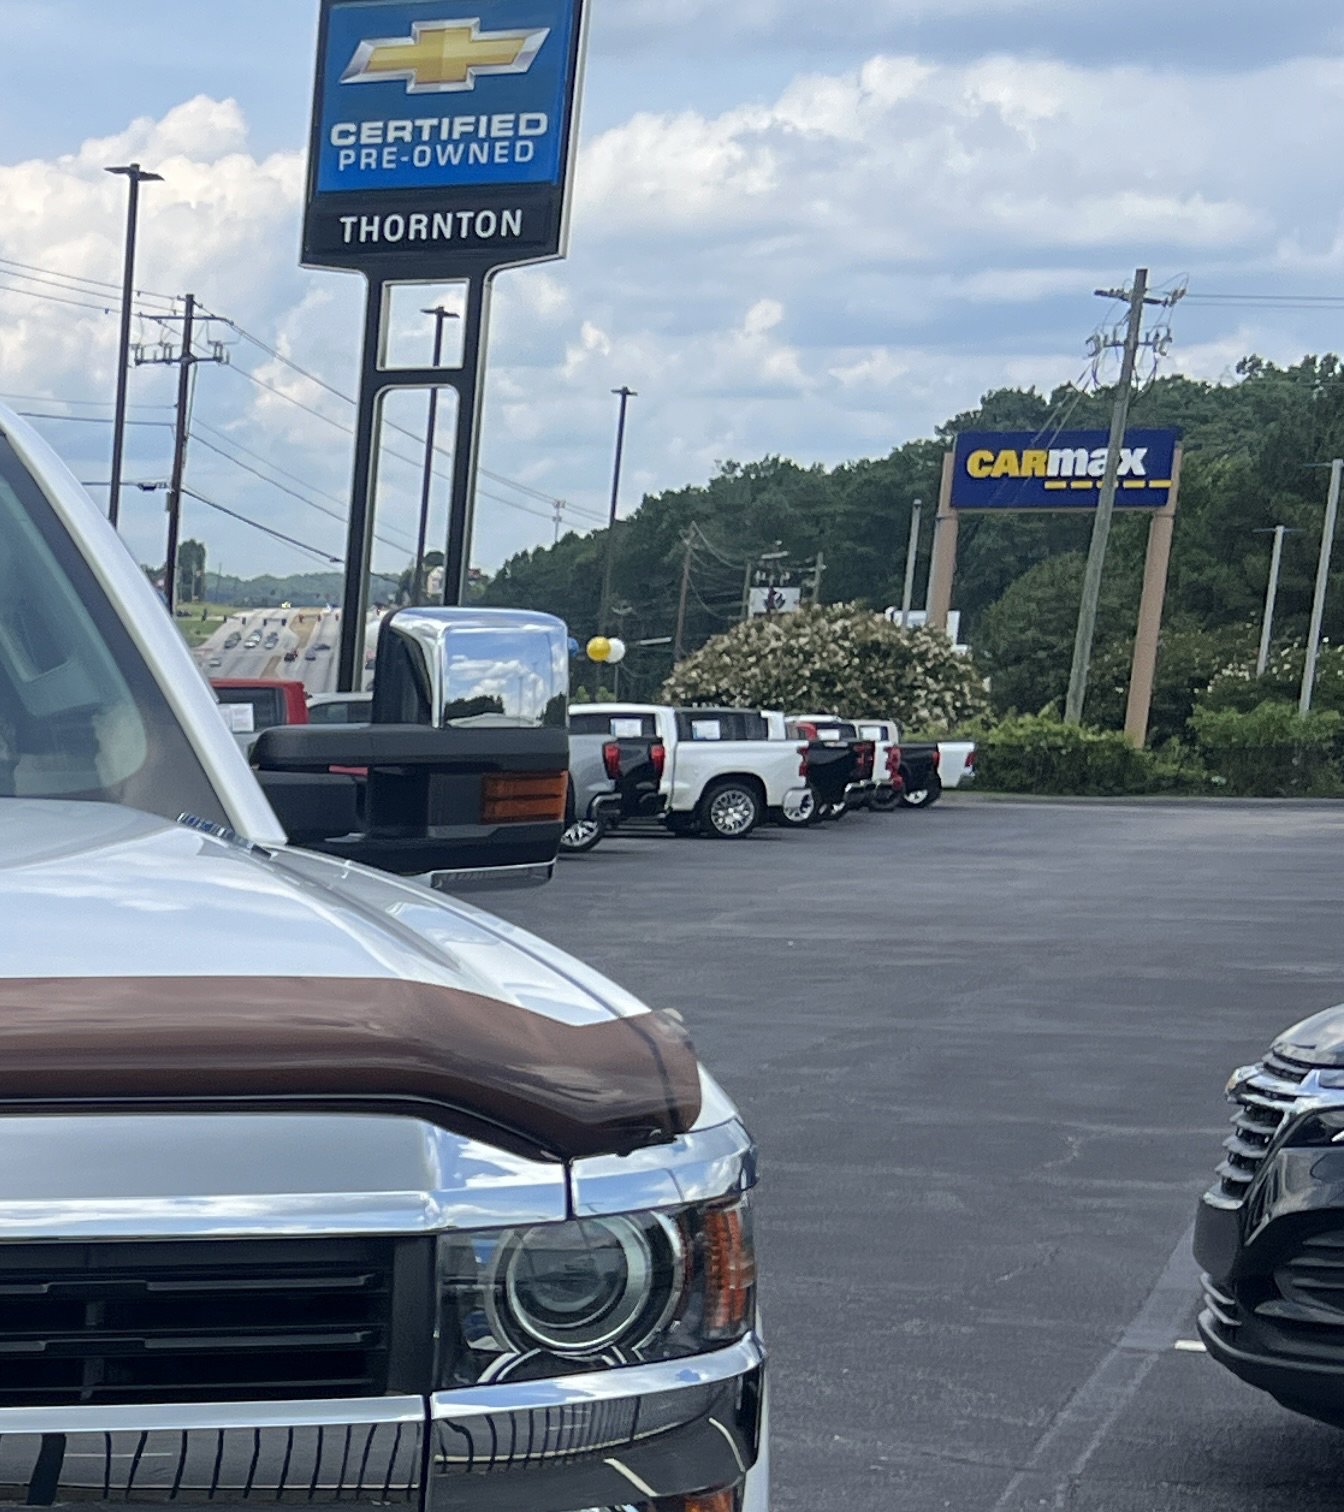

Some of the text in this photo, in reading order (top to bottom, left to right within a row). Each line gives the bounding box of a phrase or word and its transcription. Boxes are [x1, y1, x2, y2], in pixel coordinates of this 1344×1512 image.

[330, 112, 549, 147] CERTIFIED
[338, 140, 535, 171] PRE-OWNED
[339, 209, 523, 243] THORNTON
